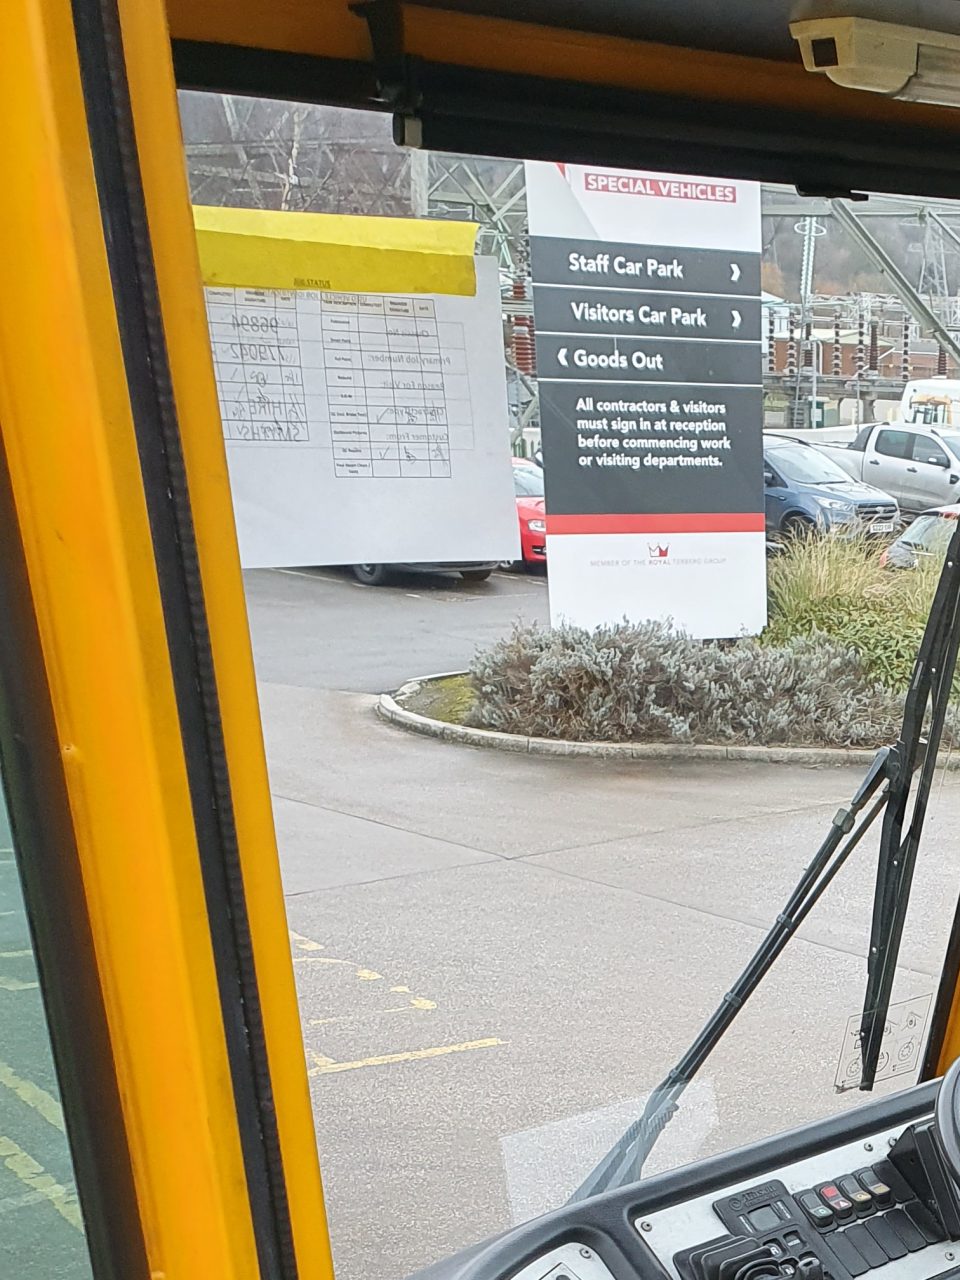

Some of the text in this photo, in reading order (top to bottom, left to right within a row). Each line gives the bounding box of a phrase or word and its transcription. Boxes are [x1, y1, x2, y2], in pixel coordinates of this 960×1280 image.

[587, 175, 734, 201] SPECIAL VEHICLES
[568, 252, 684, 279] Staff Car Park
[570, 301, 707, 327] Visitors Car Park
[573, 349, 664, 370] Goods Out
[576, 397, 726, 414] All contractors & visitors
[577, 417, 726, 434] must sign in at reception
[577, 434, 732, 451] before commencing work
[578, 453, 723, 469] or visiting departments.
